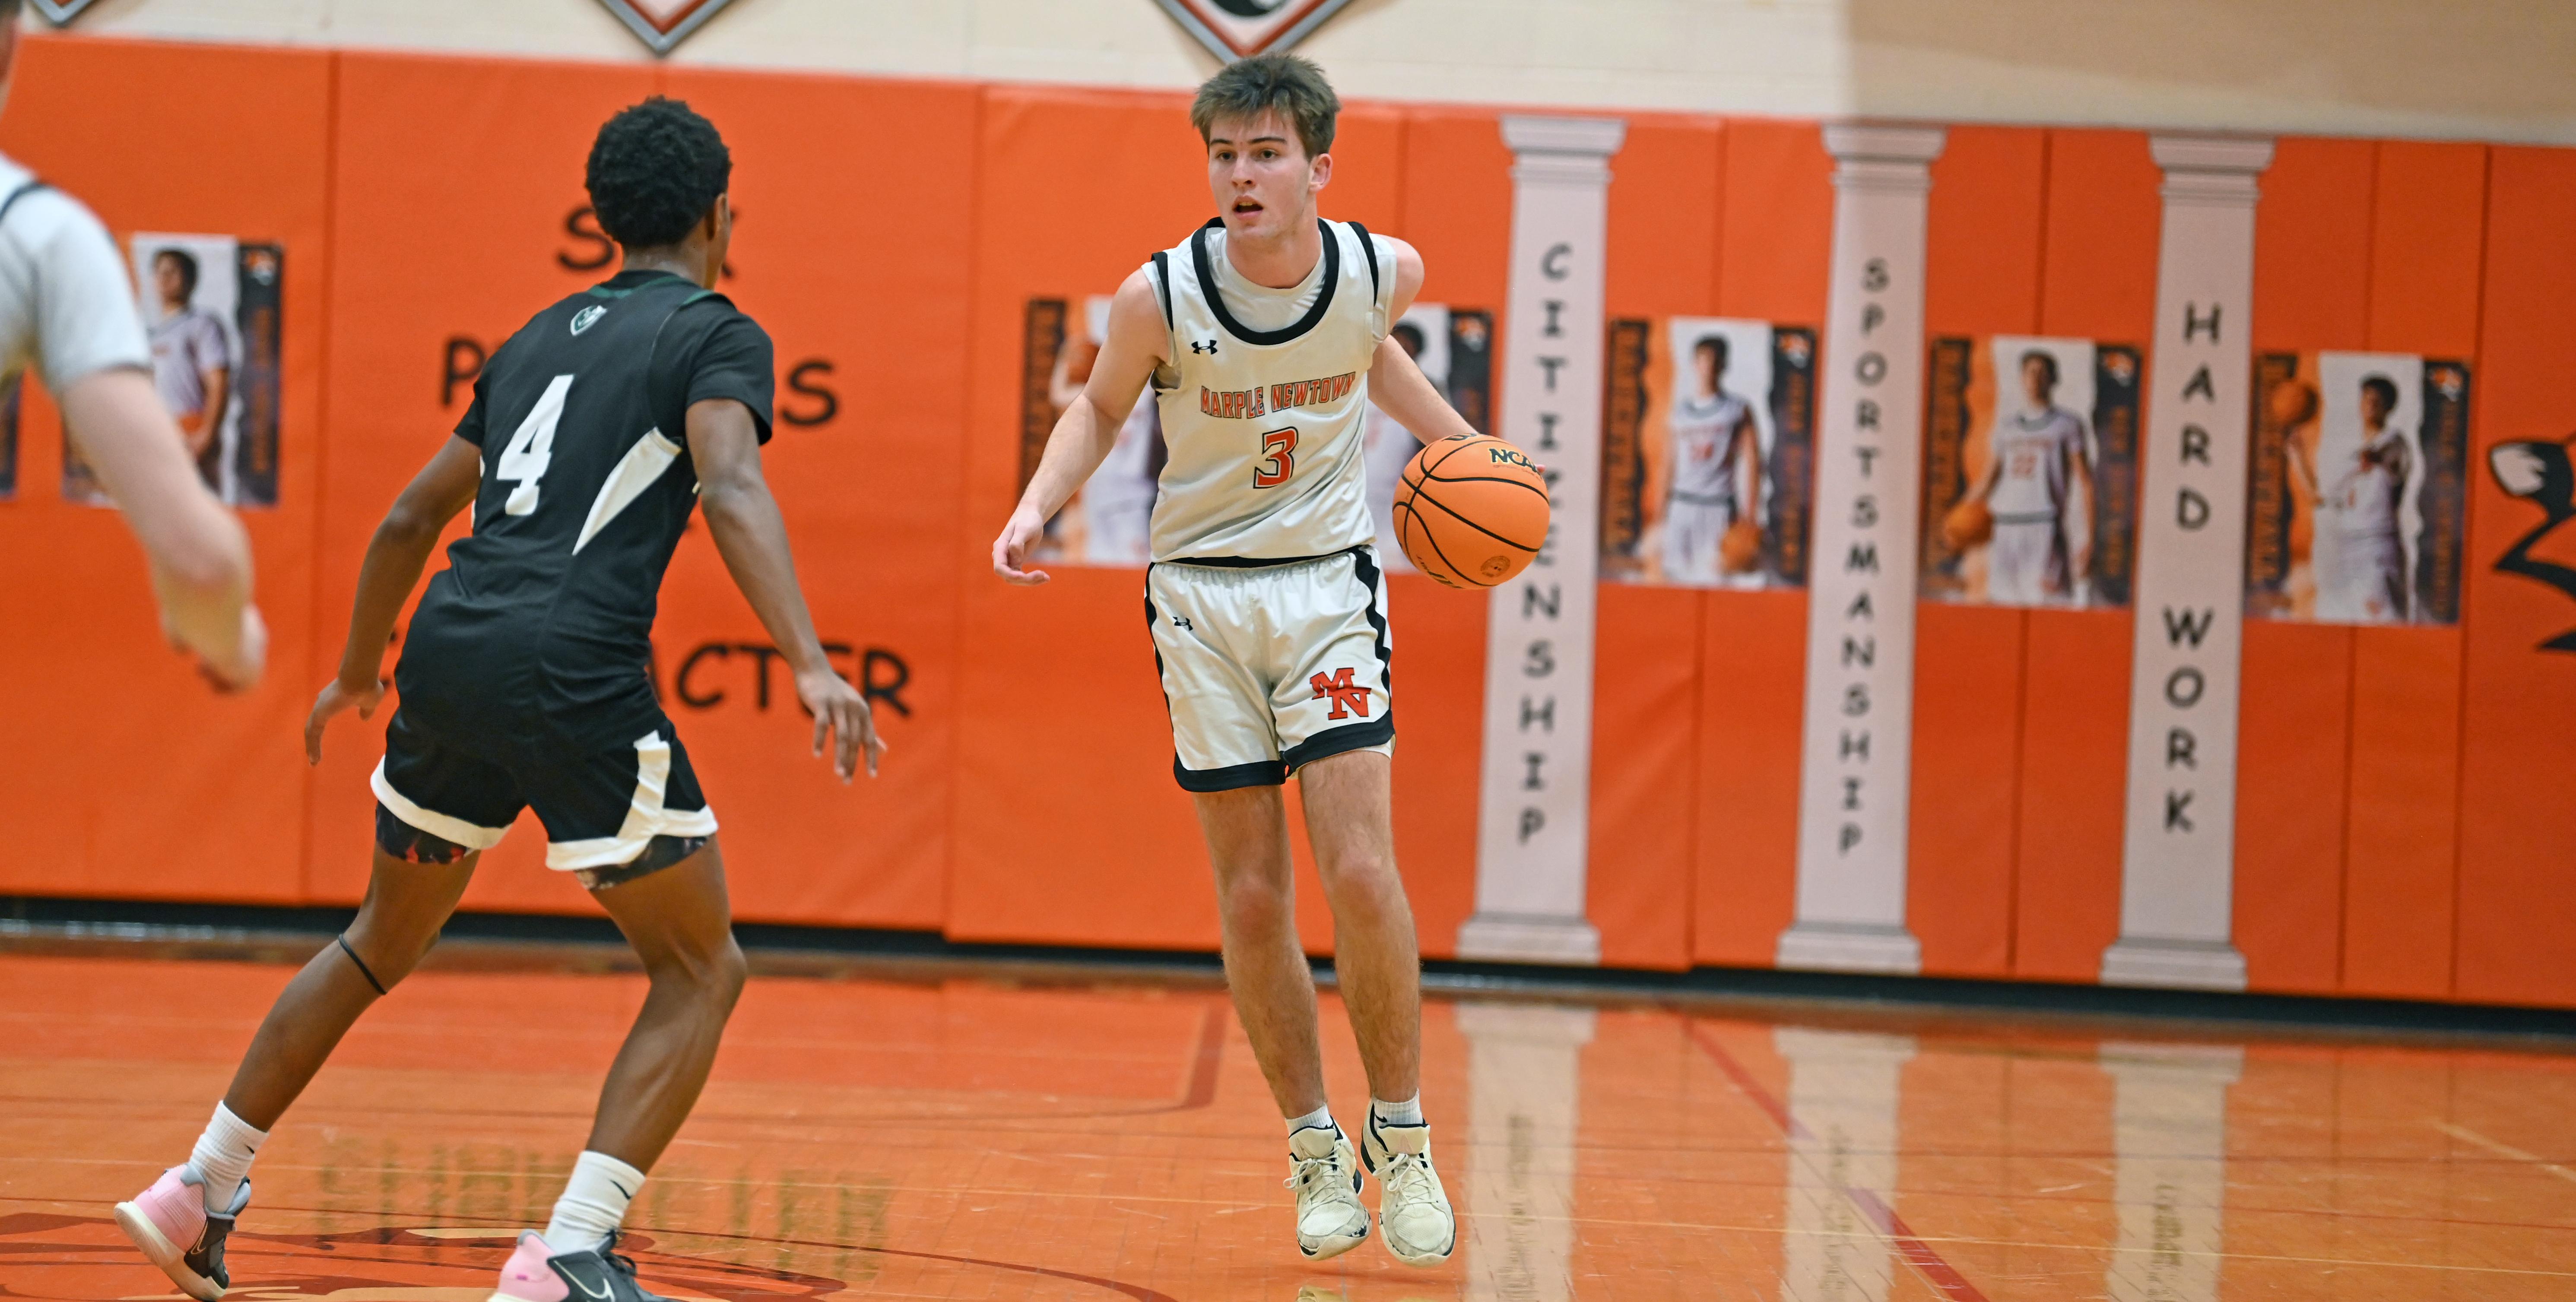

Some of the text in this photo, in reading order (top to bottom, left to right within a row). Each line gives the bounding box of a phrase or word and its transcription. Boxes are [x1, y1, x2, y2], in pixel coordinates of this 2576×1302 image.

[496, 374, 574, 516] 4
[1200, 371, 1356, 419] MARPLE NEWTOWN
[1253, 426, 1298, 489] 3
[1837, 257, 1890, 857] SPORTSMANSHIP
[2164, 301, 2221, 831] HARD WORK
